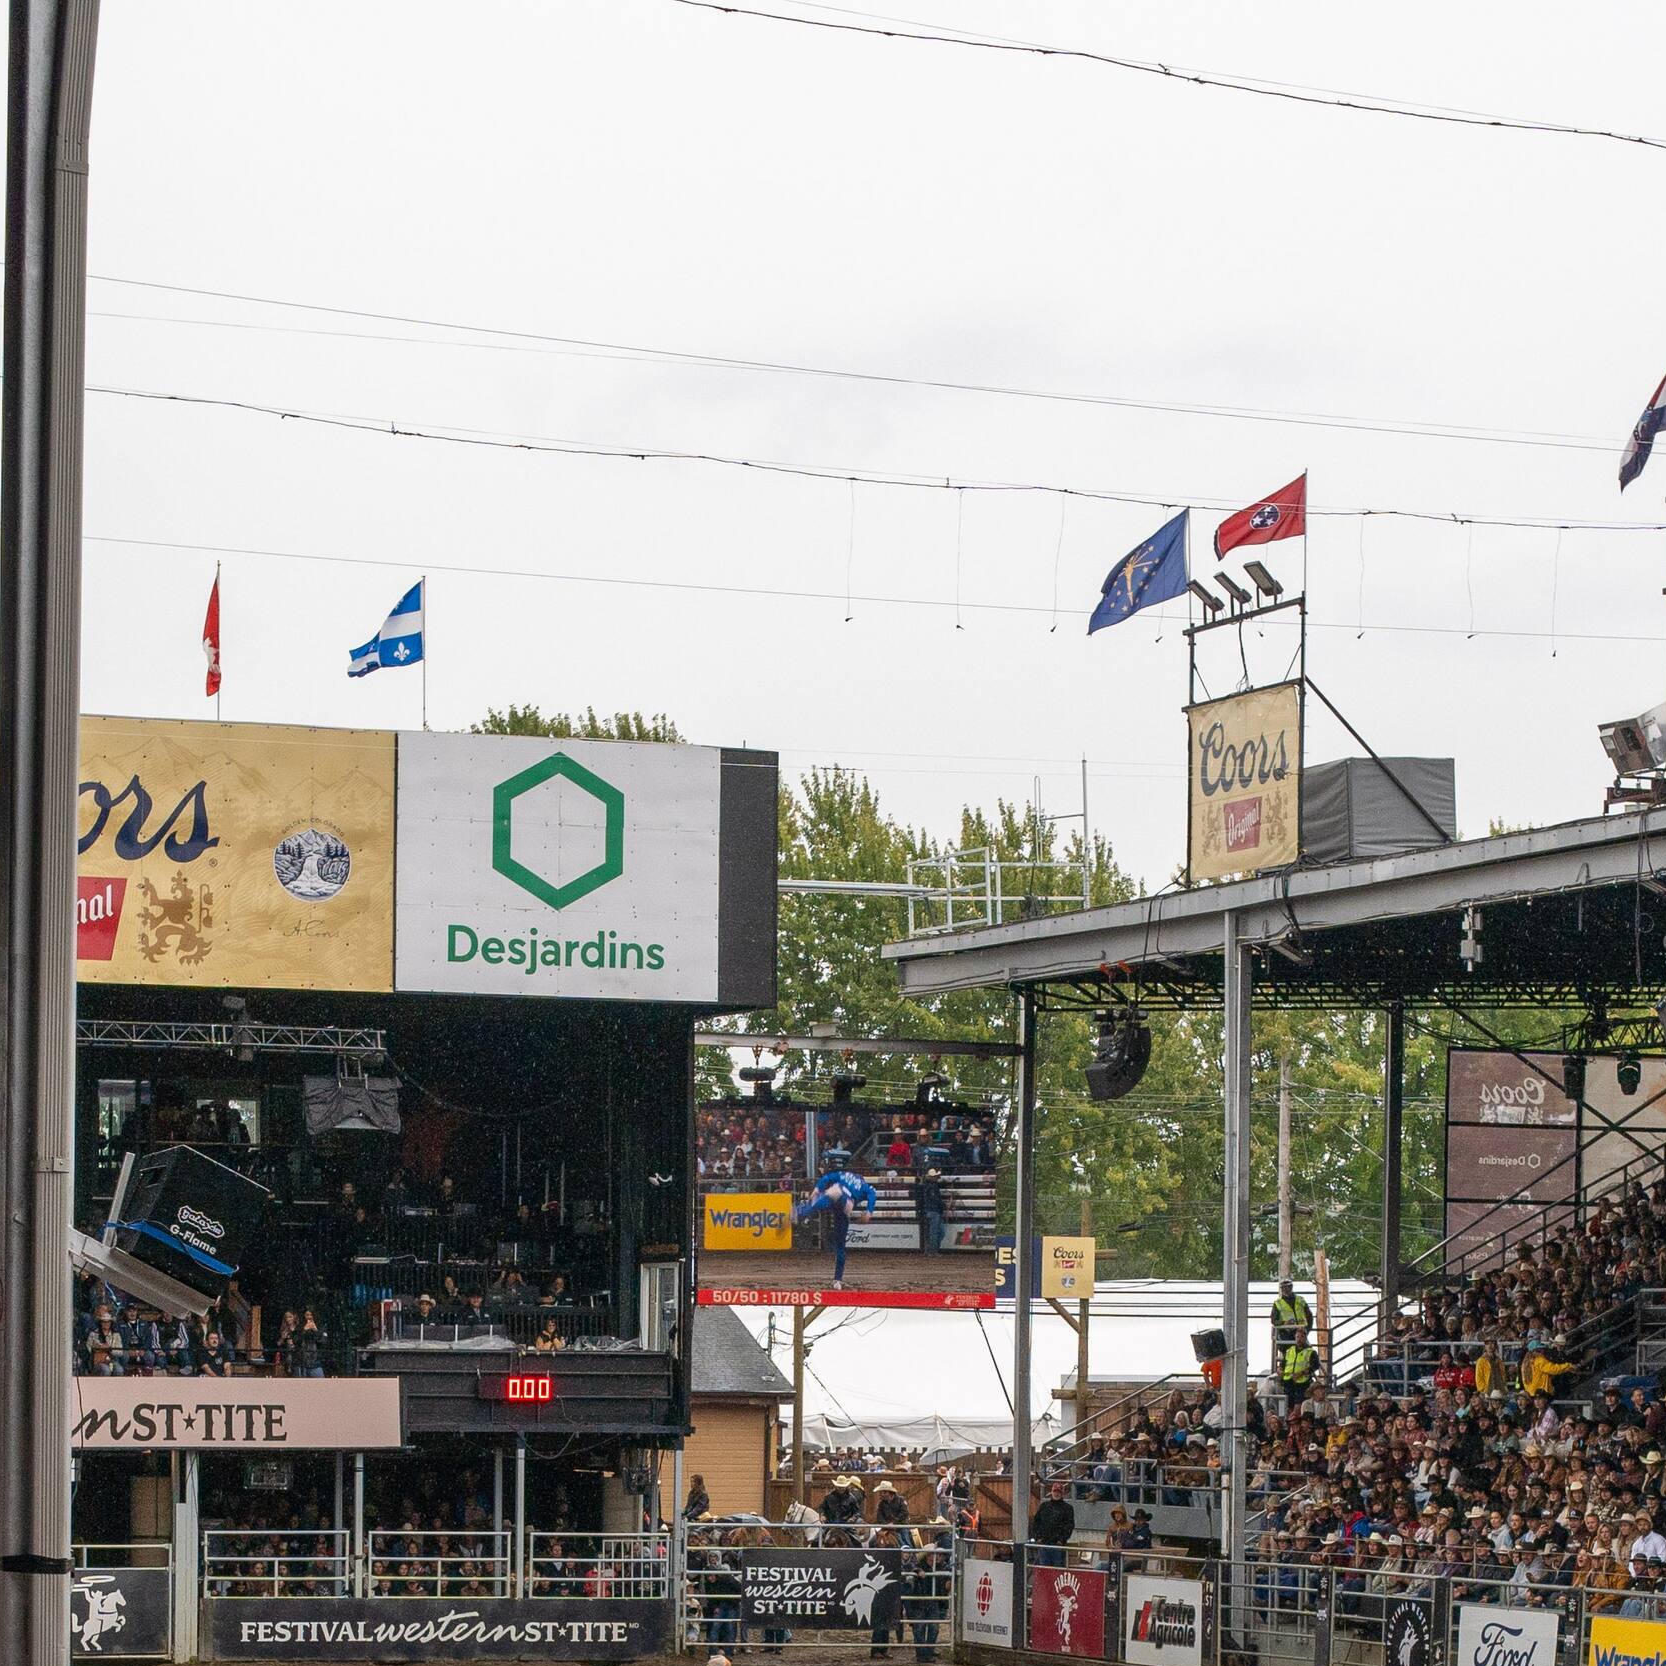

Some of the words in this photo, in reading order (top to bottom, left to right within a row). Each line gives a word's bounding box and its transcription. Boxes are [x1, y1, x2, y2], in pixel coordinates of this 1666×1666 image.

[1199, 720, 1289, 797] Coors
[309, 817, 346, 838] COLORADO
[1228, 800, 1260, 847] Original
[447, 925, 665, 974] Desjardins
[709, 1208, 786, 1236] Wrangler
[170, 1224, 217, 1255] G-Flame
[1053, 1246, 1085, 1260] Coors
[712, 1290, 758, 1304] 50/50
[771, 1291, 811, 1304] 11780
[813, 1291, 822, 1304] $
[508, 1377, 552, 1401] 0.00
[746, 1567, 837, 1582] FESTIVAL
[1054, 1572, 1081, 1597] FIREBALL
[744, 1579, 836, 1599] western
[240, 1622, 374, 1643] FESTIVAL
[374, 1609, 526, 1643] western
[1158, 1598, 1196, 1626] Centre
[1387, 1601, 1409, 1646] FESTIVAL
[1411, 1602, 1430, 1650] WESTERN
[1149, 1615, 1196, 1649] Agricole
